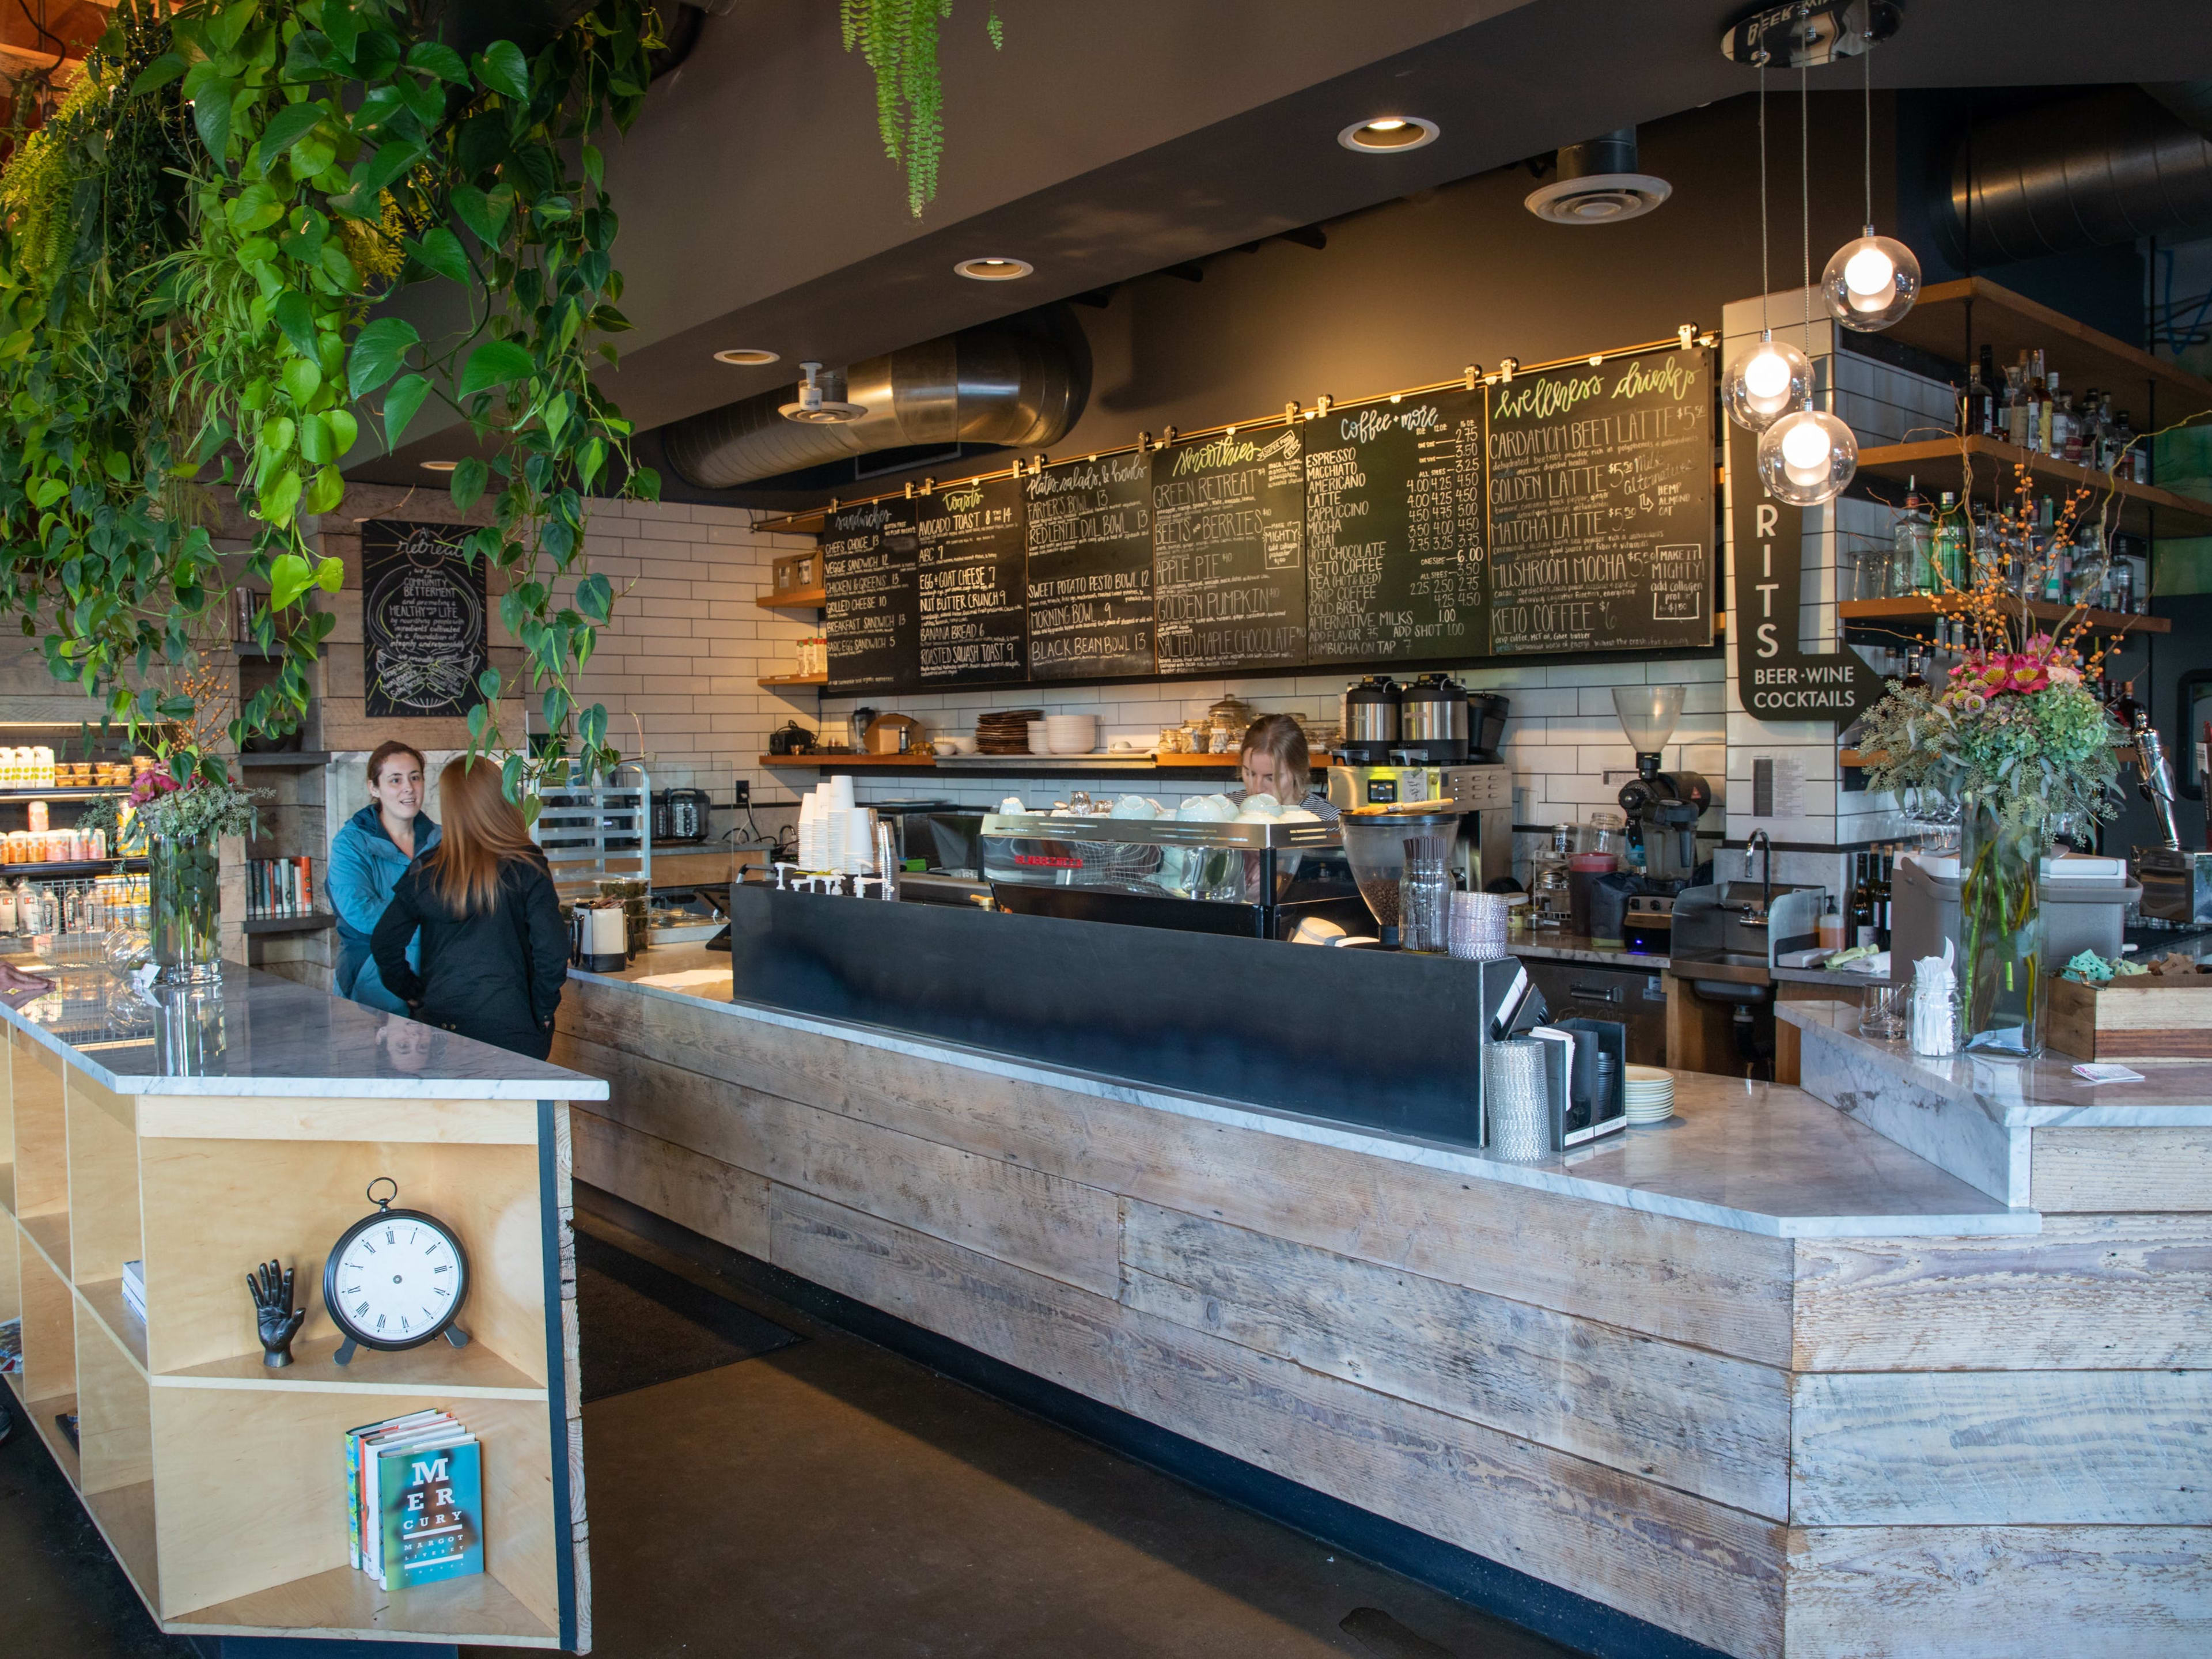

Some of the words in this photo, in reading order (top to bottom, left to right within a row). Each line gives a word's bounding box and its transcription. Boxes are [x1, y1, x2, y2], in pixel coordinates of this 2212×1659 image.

[1494, 375, 1604, 420] wellness
[1612, 356, 1702, 400] drinks
[1341, 410, 1392, 444] coffee
[1402, 405, 1438, 430] more
[1489, 424, 1568, 460] CARDAMOM
[1571, 417, 1611, 450] BEET
[1617, 406, 1675, 444] LATTE
[1456, 426, 1478, 444] 2.75
[1172, 435, 1262, 476] smoothies
[1305, 447, 1356, 468] ESPRESSO
[1456, 442, 1478, 458] 3.50
[1112, 455, 1147, 482] bowls
[1306, 461, 1357, 482] MACCHIATO
[1456, 458, 1479, 473] 3.25
[1492, 457, 1529, 472] dehydrated
[1153, 480, 1195, 509] GREEN
[1199, 469, 1257, 502] RETREAT
[1308, 472, 1366, 494] AMERICANO
[1407, 479, 1429, 493] 4.00
[1431, 476, 1452, 490] 4.25
[1457, 472, 1479, 487] 4.50
[1490, 475, 1541, 505] GOLDEN
[1548, 464, 1607, 499] LATTE
[1658, 482, 1682, 494] HEMP
[942, 487, 984, 512] toasts
[1028, 497, 1065, 520] FARMER'S
[1067, 495, 1090, 513] BOWL
[1097, 490, 1108, 507] 13
[1306, 491, 1342, 509] LATTE
[1407, 494, 1430, 508] 4.00
[1431, 491, 1452, 506] 4.25
[1456, 487, 1478, 502] 4.50
[1658, 493, 1691, 505] ALMOND
[835, 505, 892, 531] sandwiches
[1306, 500, 1369, 522] CAPPUCCINO
[1458, 503, 1478, 517] 5.00
[918, 517, 950, 537] AVOCADO
[952, 512, 980, 531] TOAST
[1030, 527, 1048, 546] RED
[1048, 522, 1078, 543] LENTIL
[1081, 517, 1101, 538] DAL
[1103, 512, 1128, 536] BOWL
[1137, 509, 1148, 529] 13
[1155, 519, 1191, 545] BEETS
[1202, 509, 1263, 540] BERRIES
[1306, 519, 1342, 536] MOCHA
[1490, 516, 1548, 546] MATCHA
[1553, 510, 1607, 540] LATTE
[825, 540, 845, 555] CHEFS
[847, 536, 868, 551] CHOICE
[873, 535, 879, 547] 13
[1265, 528, 1298, 543] MIGHTY
[1311, 533, 1335, 549] CHAI
[919, 547, 934, 563] ABC
[1307, 548, 1327, 562] HOT
[1330, 541, 1387, 560] CHOCOLATE
[1457, 547, 1484, 563] 6.00
[1660, 550, 1684, 561] MAKE
[1686, 550, 1698, 560] IT
[825, 560, 846, 574] VEGGIE
[847, 556, 878, 571] SANDWICH
[882, 554, 889, 566] 12
[1156, 557, 1191, 585] APPLE
[1195, 554, 1222, 580] PIE
[1308, 560, 1339, 578] KETO
[1342, 556, 1384, 575] COFFEE
[1491, 559, 1569, 589] MUSHROOM
[1573, 554, 1627, 584] MOCHA
[1652, 560, 1705, 580] MIGHTY!
[403, 577, 448, 588] COMMUNITY
[826, 579, 852, 594] CHICKEN
[859, 575, 887, 589] GREENS
[892, 573, 899, 585] 13
[919, 573, 934, 590] EGG
[939, 570, 957, 588] GOAT
[958, 566, 984, 586] CHEESE
[1028, 581, 1054, 599] SWEET
[1057, 577, 1086, 594] POTATO
[1089, 574, 1112, 592] PESTO
[1115, 572, 1139, 589] BOWL
[1141, 570, 1150, 588] 12
[1308, 575, 1330, 590] TEA
[1650, 580, 1668, 592] add
[1669, 580, 1703, 595] collagen
[403, 586, 457, 598] BETTERMENT
[920, 597, 935, 612] NUT
[937, 594, 967, 611] BUTTER
[968, 591, 998, 608] CRUNCH
[1310, 588, 1334, 604] DRIP
[1337, 584, 1377, 602] COFFEE
[389, 605, 426, 617] HEALTHY
[439, 607, 459, 618] LIFE
[826, 600, 850, 614] GRILLED
[851, 596, 876, 611] CHEESE
[1157, 594, 1203, 622] GOLDEN
[1207, 588, 1268, 616] PUMPKIN
[1308, 602, 1335, 617] COLD
[1336, 600, 1367, 615] BREW
[827, 618, 861, 632] BREAKFAST
[864, 615, 894, 630] SANDWICH
[1031, 605, 1070, 630] MORNING
[1072, 603, 1096, 624] BOWL
[1309, 612, 1376, 631] ALTERNATIVE
[1380, 611, 1414, 627] MILKS
[1491, 605, 1528, 635] KETO
[1533, 602, 1595, 633] COFFEE
[920, 626, 949, 642] BANANA
[951, 623, 977, 639] BREAD
[1327, 628, 1361, 642] FLAVOR
[1393, 626, 1412, 638] ADD
[1415, 623, 1443, 637] SHOT
[827, 640, 841, 653] BASIC
[854, 637, 886, 650] SANDWICH
[1032, 638, 1071, 661] BLACK
[1074, 636, 1103, 656] BEAN
[1104, 635, 1130, 654] BOWL
[1135, 632, 1146, 651] 13
[1158, 634, 1196, 658] SALTED
[1198, 630, 1233, 656] MAPLE
[1234, 626, 1296, 653] CHOCOLATE
[1308, 642, 1359, 655] KOMBUCHA
[1361, 642, 1375, 653] ON
[1377, 640, 1396, 654] TAP
[921, 647, 951, 665] ROASTED
[953, 645, 979, 663] SQUASH
[981, 643, 1005, 662] TOAST
[1754, 690, 1855, 709] COCKTAILS
[404, 1535, 464, 1551] MARGOT
[404, 1546, 464, 1560] LIVESEY
